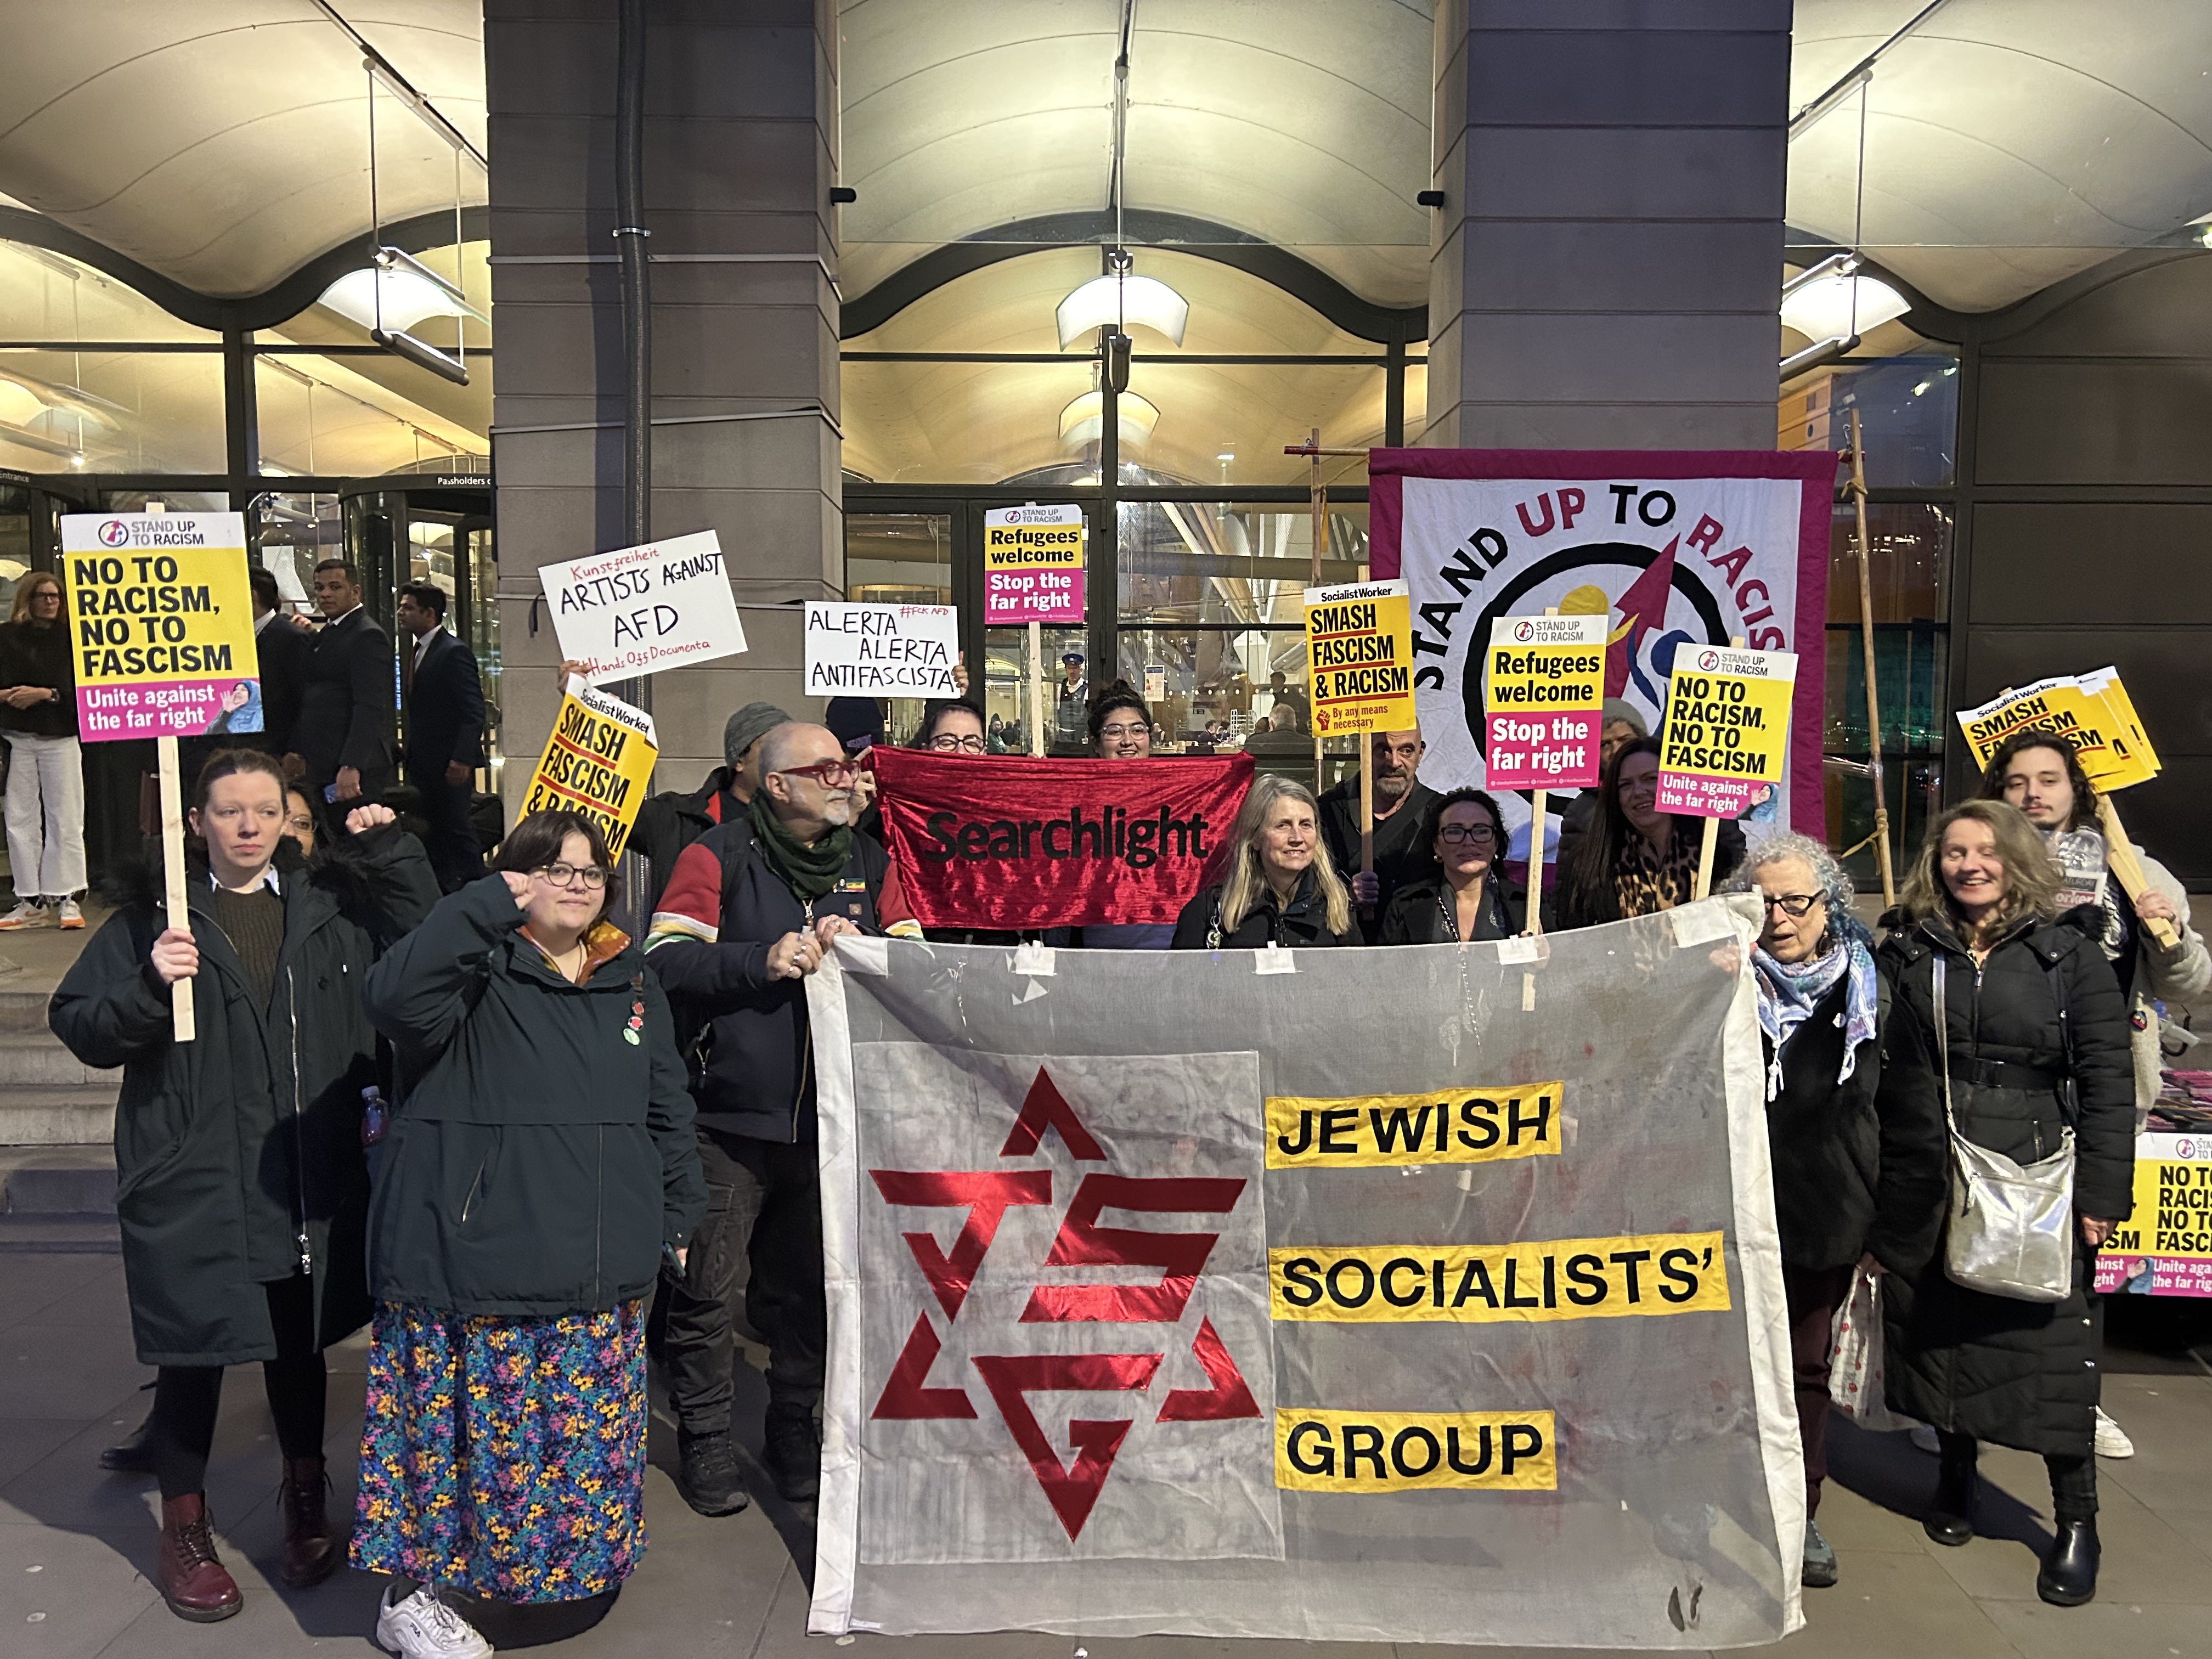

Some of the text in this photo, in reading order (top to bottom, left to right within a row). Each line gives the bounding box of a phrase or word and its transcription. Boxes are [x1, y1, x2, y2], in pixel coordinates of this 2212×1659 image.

[132, 521, 196, 533] STAND UP
[132, 533, 204, 546] TO RACISM
[991, 529, 1078, 546] Refugees
[570, 548, 660, 582] Kunstfreiheit
[991, 548, 1074, 563] welcome
[74, 556, 178, 586] NO TO
[561, 553, 722, 614] ARTISTS AGAINST
[990, 572, 1071, 592] Stop the
[77, 585, 221, 616] RACISM,
[1412, 484, 1786, 691] STAND UP TO RACIS
[899, 606, 949, 618] #FCK AFD
[990, 591, 1071, 611] far right
[79, 616, 186, 646] NO TO
[614, 605, 679, 647] AFD
[809, 610, 898, 636] ALERTA
[1311, 603, 1376, 634] SMASH
[1536, 621, 1580, 631] STAND UP
[1536, 631, 1583, 641] TO RACISM
[82, 644, 233, 678] FASCISM
[859, 638, 948, 665] ALERTA
[1312, 635, 1394, 667] FASCISM
[1721, 653, 1765, 665] STAND UP
[812, 662, 954, 692] ANTIFASCISTA
[1496, 651, 1600, 679] Refugees
[1721, 663, 1768, 676] TO RACISM
[1316, 667, 1409, 699] & RACISM
[1494, 680, 1594, 703] welcome
[1675, 676, 1746, 703] NO TO
[86, 684, 216, 709] Unite against
[88, 706, 206, 731] the far right
[1333, 705, 1388, 720] By any means
[1334, 718, 1374, 730] necessary
[1672, 699, 1767, 731] RACISM,
[1970, 697, 2049, 740] SMASH
[560, 703, 627, 761] SMASH
[1492, 716, 1588, 747] Stop the
[1669, 722, 1741, 748] NO TO
[1492, 745, 1585, 774] far right
[1666, 744, 1767, 775] FASCISM
[541, 742, 630, 808] FASCISM
[1663, 774, 1749, 795] Unite against
[1661, 791, 1739, 814] the far right
[924, 805, 1209, 868] Searchlight
[2056, 890, 2094, 904] orker
[1277, 1096, 1551, 1155] JEWISH
[2196, 1141, 2212, 1149] STA
[2160, 1166, 2212, 1187] NO T
[2159, 1188, 2212, 1209] RACI
[2157, 1210, 2212, 1231] NO T
[2156, 1231, 2212, 1252] FASC
[1282, 1247, 1713, 1308] SOCIALISTS'
[2154, 1259, 2186, 1273] Unite
[2093, 1272, 2114, 1287] ght
[2153, 1274, 2172, 1288] the
[2175, 1276, 2193, 1288] far
[1286, 1421, 1543, 1479] GROUP
